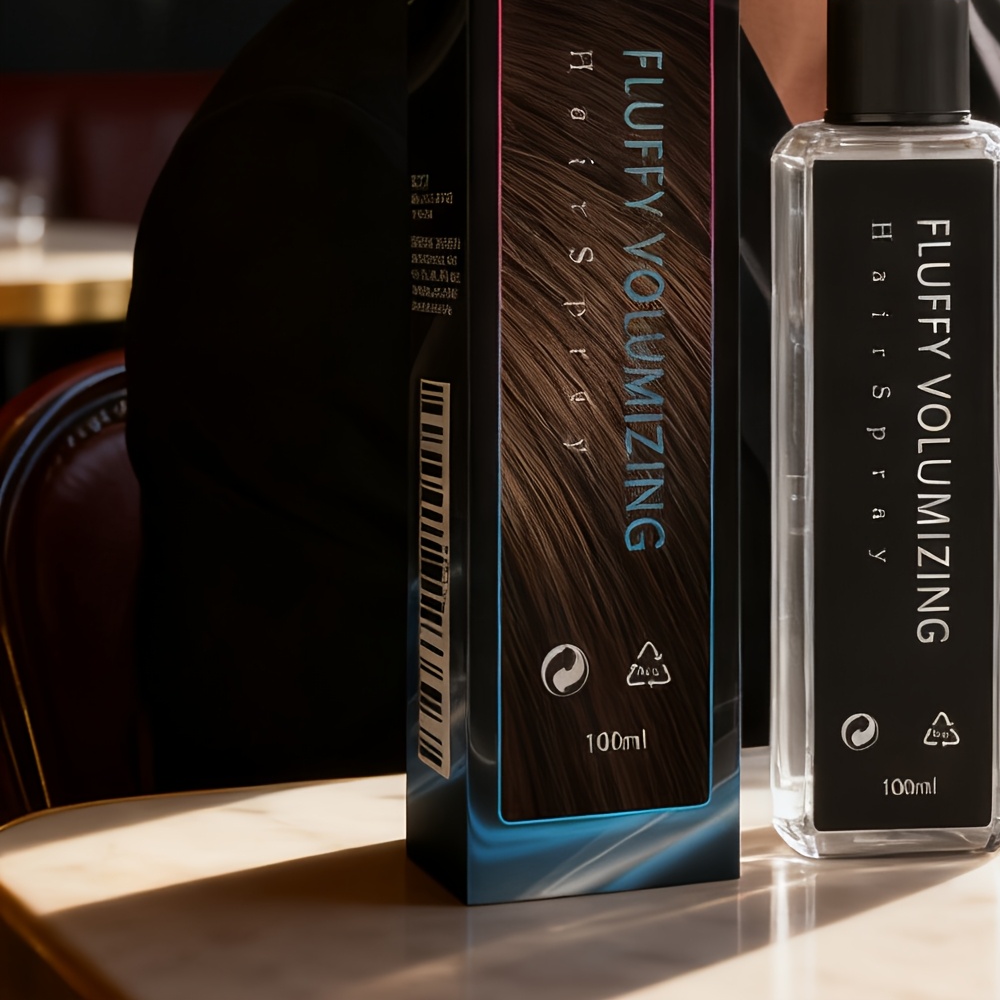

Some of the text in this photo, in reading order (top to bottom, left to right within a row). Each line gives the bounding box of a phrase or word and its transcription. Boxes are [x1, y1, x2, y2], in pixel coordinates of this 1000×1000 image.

[622, 50, 666, 551] FLUFFY VOLUMIZING
[916, 219, 952, 644] FLUFFY VOLUMIZING
[586, 729, 647, 753] 100ml
[883, 776, 937, 796] 100ml
